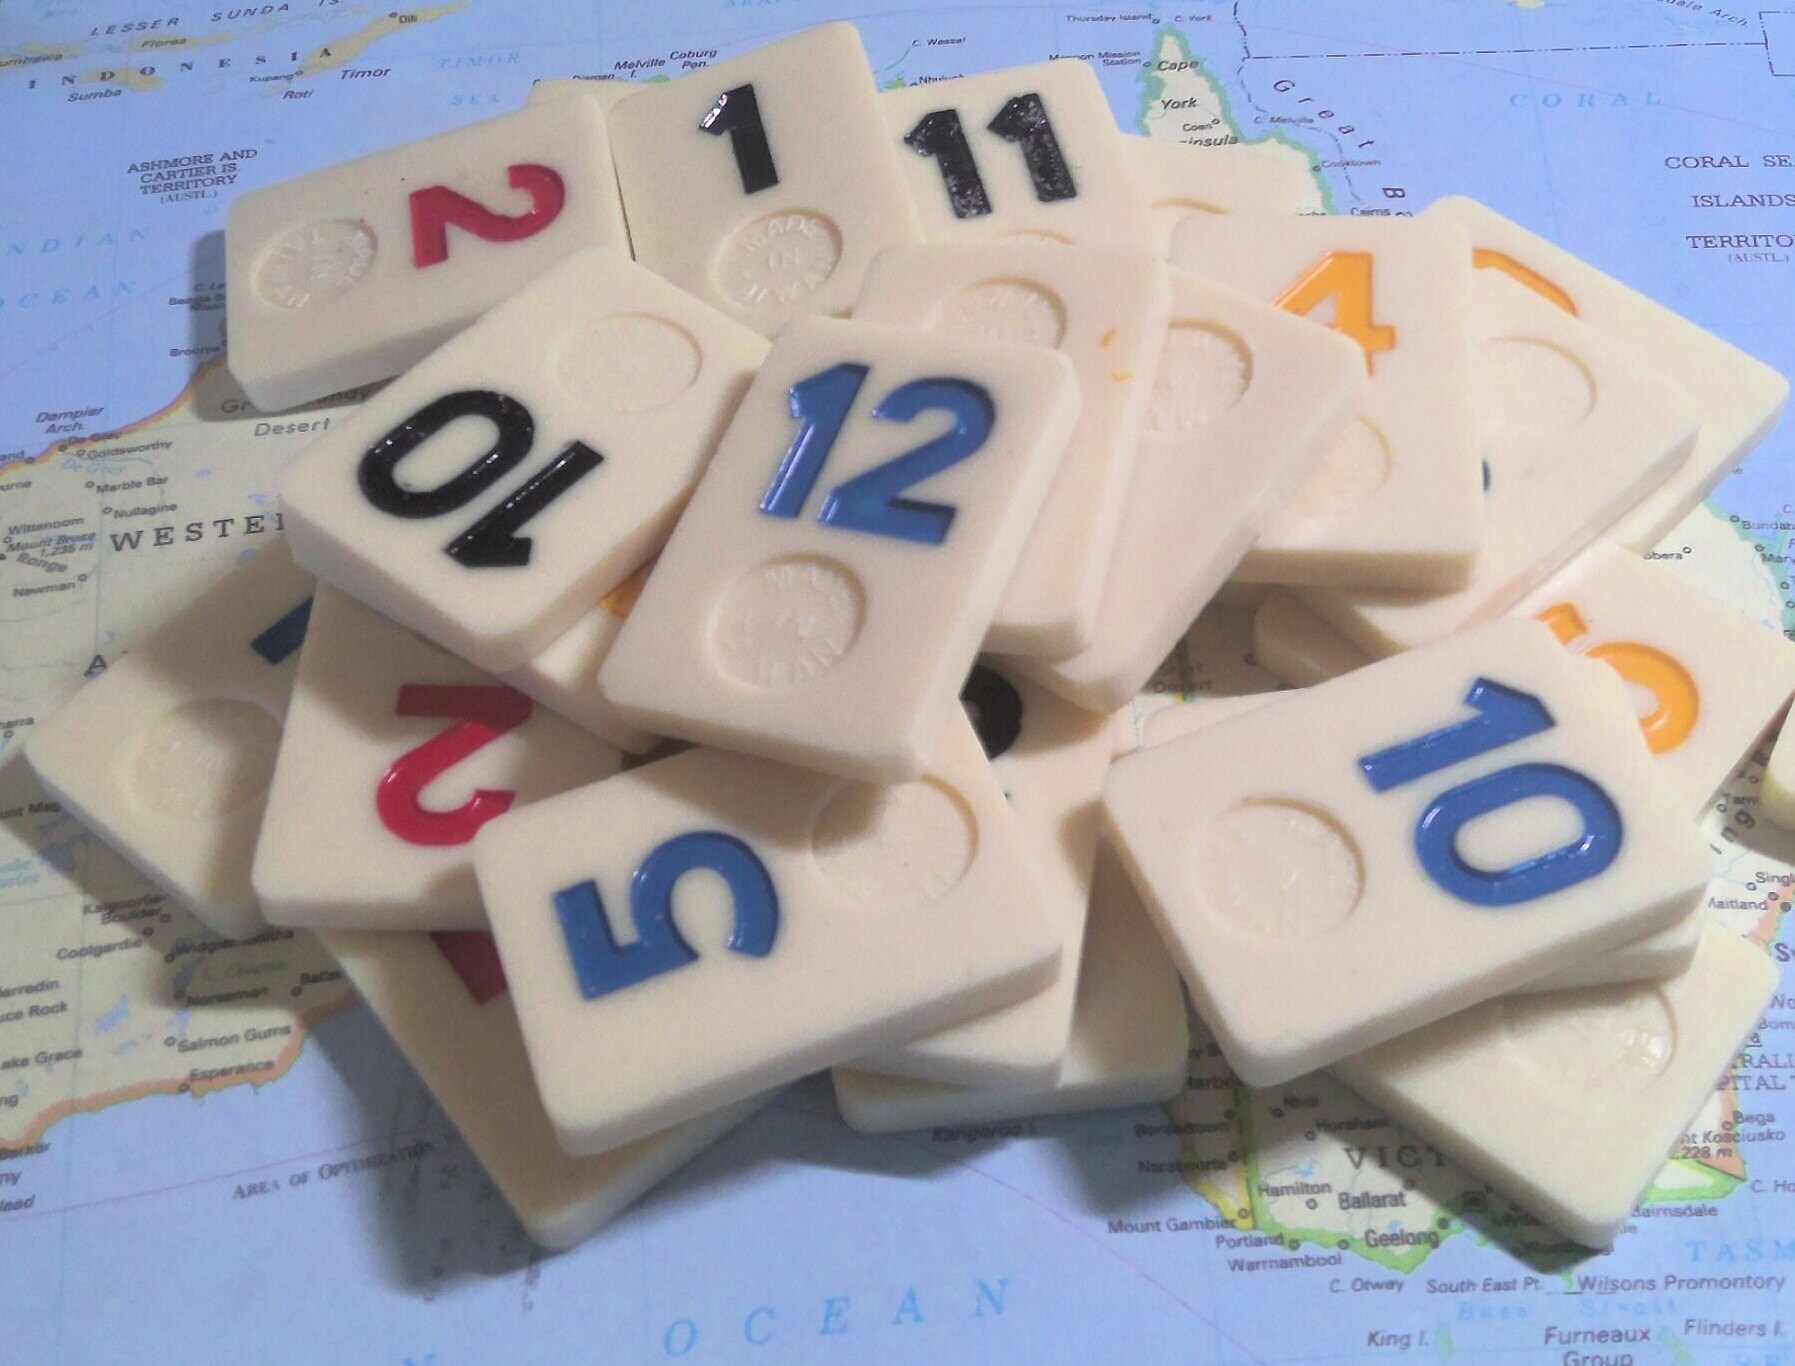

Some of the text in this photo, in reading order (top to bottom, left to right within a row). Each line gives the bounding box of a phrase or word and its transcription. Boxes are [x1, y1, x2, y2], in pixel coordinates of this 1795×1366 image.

[90, 17, 180, 36] LESSER
[211, 4, 290, 22] SUNDA
[614, 58, 667, 71] Melville
[670, 49, 718, 62] Coburg
[340, 68, 392, 80] Timor
[682, 60, 710, 70] Pen.
[1157, 60, 1200, 73] Cape
[67, 89, 123, 102] Sumba
[1160, 97, 1198, 111] York
[698, 83, 779, 194] 1
[127, 149, 258, 174] ASHMORE AND
[903, 92, 1077, 219] 11
[1664, 154, 1795, 169] CORAL SE
[140, 165, 217, 184] CARTIER
[139, 174, 238, 195] TERRITORY
[1691, 193, 1795, 208] ISLANDS
[409, 163, 566, 269] 2
[1685, 234, 1795, 249] TERRITO
[36, 407, 105, 424] Dampier
[254, 418, 330, 437] Desert
[87, 440, 173, 461] Goldsworthy
[759, 362, 996, 546] 12
[146, 476, 169, 487] Bar
[357, 389, 605, 569] 10
[8, 517, 85, 536] Wittenoom
[7, 537, 52, 553] Mount
[13, 581, 76, 598] Newman
[1357, 676, 1623, 907] 10
[551, 829, 779, 1002] 5
[29, 1000, 68, 1017] Rock
[177, 1023, 292, 1053] Salmon Gums
[0, 1048, 83, 1070] ake Grace
[188, 1059, 275, 1081] Esperance
[1733, 1110, 1776, 1126] Bega
[1703, 1128, 1786, 1144] Kosciusko
[1257, 1181, 1333, 1198] Hamilton
[1338, 1191, 1407, 1211] Ballarat
[1108, 1217, 1236, 1234] Mount Gambier
[1215, 1232, 1285, 1249] Portland
[1364, 1228, 1440, 1249] Geelong
[1351, 1277, 1404, 1293] Otway
[1426, 1279, 1477, 1294] South
[1482, 1277, 1517, 1292] East
[1577, 1274, 1787, 1292] Wilsons Promontory
[663, 1277, 1010, 1357] OCEAN
[1544, 1326, 1652, 1346] Furneaux
[1684, 1318, 1768, 1337] Flinders
[1367, 1329, 1412, 1350] King
[1563, 1350, 1635, 1366] Group
